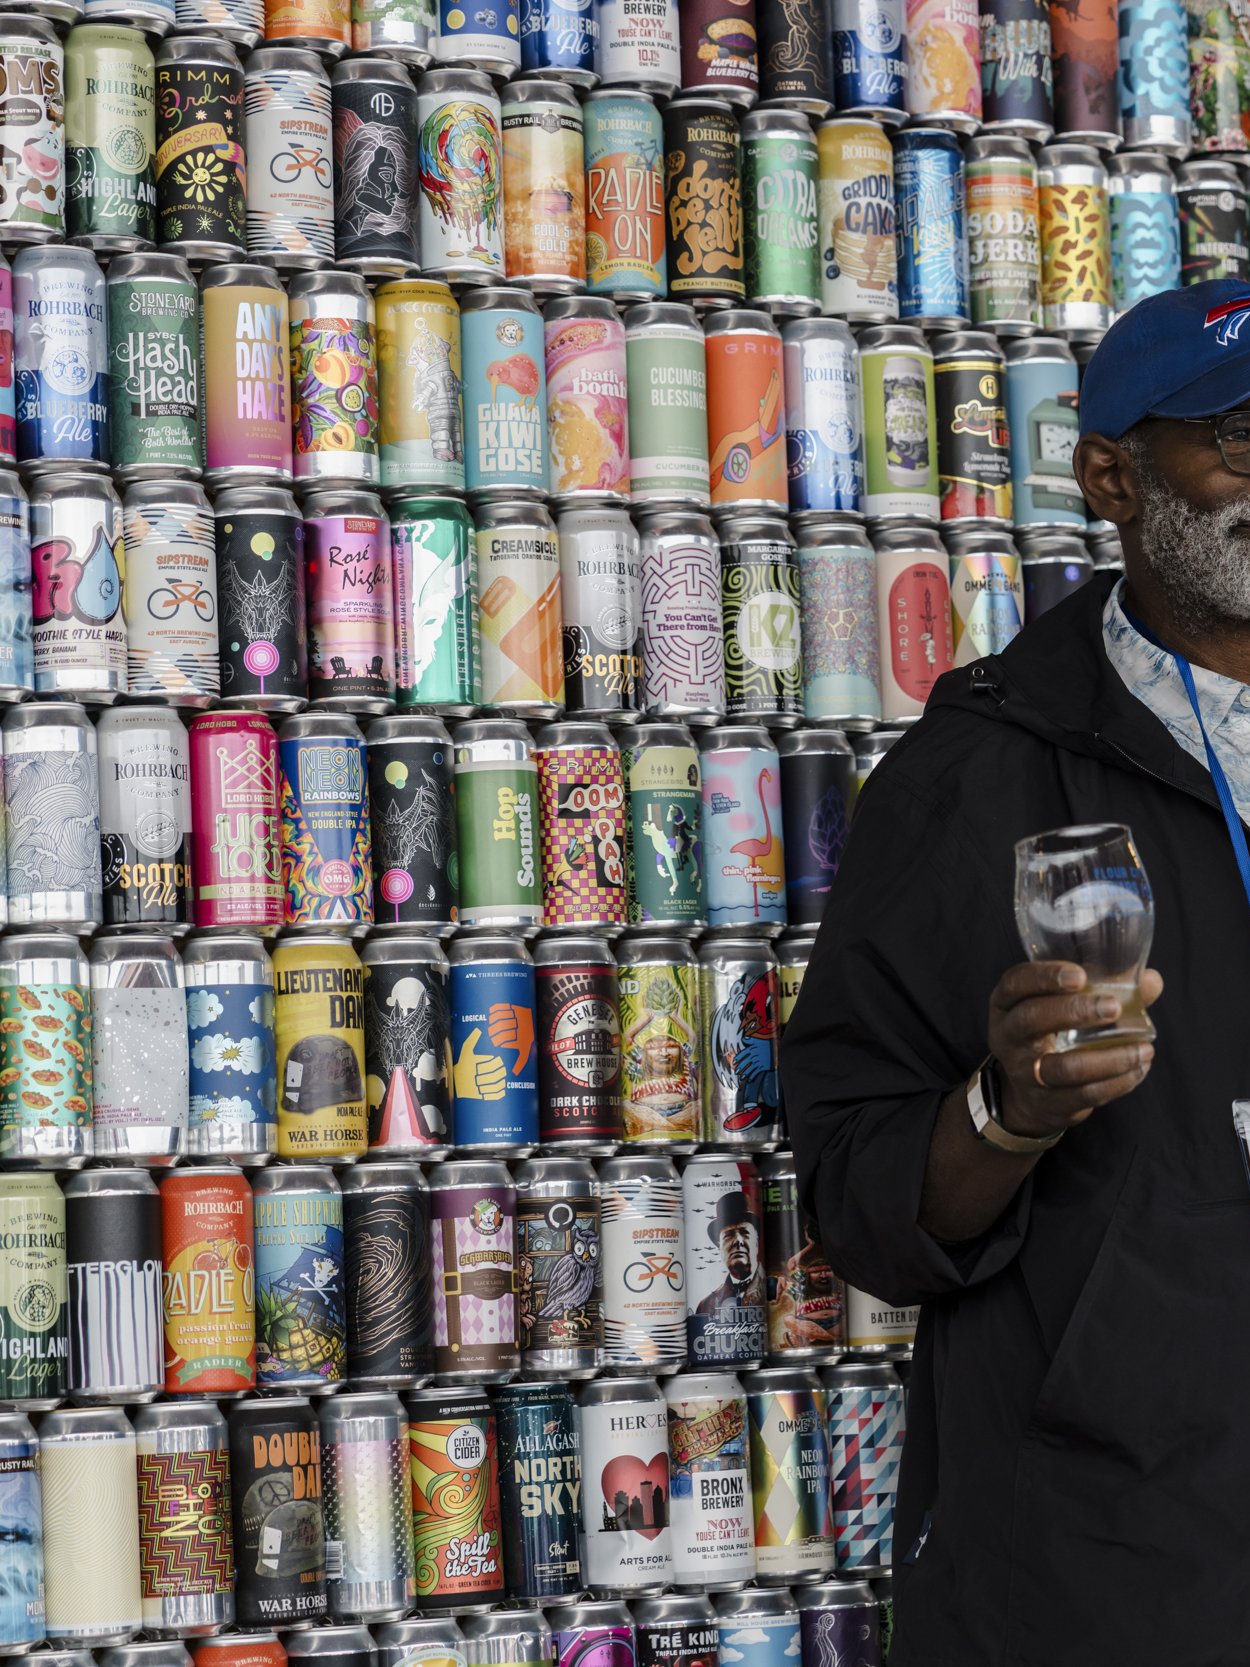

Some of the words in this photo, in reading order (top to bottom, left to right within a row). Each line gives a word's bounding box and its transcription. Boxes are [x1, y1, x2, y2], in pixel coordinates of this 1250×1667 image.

[624, 3, 667, 16] BREWERY
[628, 18, 665, 28] NOW
[556, 29, 591, 55] Ale
[711, 59, 737, 68] MAPLE
[706, 67, 749, 78] BLUEBERRY
[867, 72, 899, 96] Ale
[280, 120, 329, 135] SIPSTREAM
[597, 119, 652, 132] ROHRBACH
[756, 169, 816, 215] CITRA
[99, 194, 150, 224] Lager
[757, 210, 818, 249] DREAMS
[968, 212, 1039, 239] SODA
[538, 238, 568, 253] GOLD
[613, 214, 653, 264] ON
[971, 239, 1039, 265] JERK
[600, 259, 625, 272] LEMON
[683, 279, 707, 288] PEANUT
[709, 279, 732, 289] BUTTER
[28, 300, 104, 322] ROHRBACH
[129, 292, 195, 316] STONEYARD
[142, 308, 178, 317] BREWING
[236, 303, 282, 342] ANY
[147, 332, 177, 341] SYBC
[236, 342, 284, 382] DAY'S
[580, 368, 618, 383] bath
[237, 381, 285, 422] HAZE
[27, 400, 108, 424] BLUEBERRY
[478, 403, 540, 422] GUAVA
[53, 415, 92, 444] Ale
[479, 422, 541, 450] KIWI
[479, 448, 542, 474] GOSE
[491, 540, 557, 555] CREAMSICLE
[156, 554, 209, 567] SIPSTREAM
[329, 544, 369, 567] Rosé
[664, 614, 682, 622] You
[684, 614, 706, 622] Can't
[708, 615, 718, 623] Get
[604, 671, 635, 696] Ale
[196, 721, 215, 729] LORD
[301, 750, 359, 769] NEON
[115, 763, 188, 781] ROHRBACH
[301, 770, 360, 790] NEON
[254, 795, 273, 803] HOBO
[304, 791, 359, 801] RAINBOWS
[493, 786, 517, 842] Hop
[312, 820, 343, 829] DOUBLE
[346, 820, 356, 828] IPA
[211, 814, 278, 852] JUICE
[516, 792, 535, 888] Sounds
[324, 875, 350, 883] OMG
[144, 882, 179, 909] Ale
[462, 1014, 487, 1022] LOGICAL
[567, 1059, 593, 1069] BREW
[596, 1058, 617, 1068] HOUSE
[551, 1096, 579, 1107] DARK
[288, 1130, 319, 1143] WAR
[323, 1128, 363, 1142] HORSE
[184, 1201, 243, 1216] ROHRBACH
[10, 1213, 58, 1225] BREWING
[196, 1220, 234, 1230] COMPANY
[632, 1228, 680, 1240] SIPSTREAM
[9, 1256, 58, 1271] COMPANY
[703, 1323, 759, 1339] Breakfast
[7, 1353, 62, 1385] Lager
[193, 1357, 243, 1369] RADLER
[454, 1437, 479, 1447] CITIZEN
[515, 1432, 579, 1452] ALLAGASH
[454, 1447, 480, 1460] CIDER
[514, 1455, 582, 1483] NORTH
[701, 1477, 743, 1497] BRONX
[520, 1482, 580, 1518] SKY
[702, 1496, 744, 1510] BREWERY
[707, 1517, 743, 1530] NOW
[446, 1532, 491, 1564] Spill
[445, 1560, 469, 1577] the
[469, 1557, 497, 1577] Tea
[620, 1557, 644, 1565] ARTS
[647, 1555, 664, 1563] FOR
[259, 1598, 292, 1613] WAR
[648, 1632, 682, 1648] TRÉ
[688, 1630, 719, 1646] KIND
